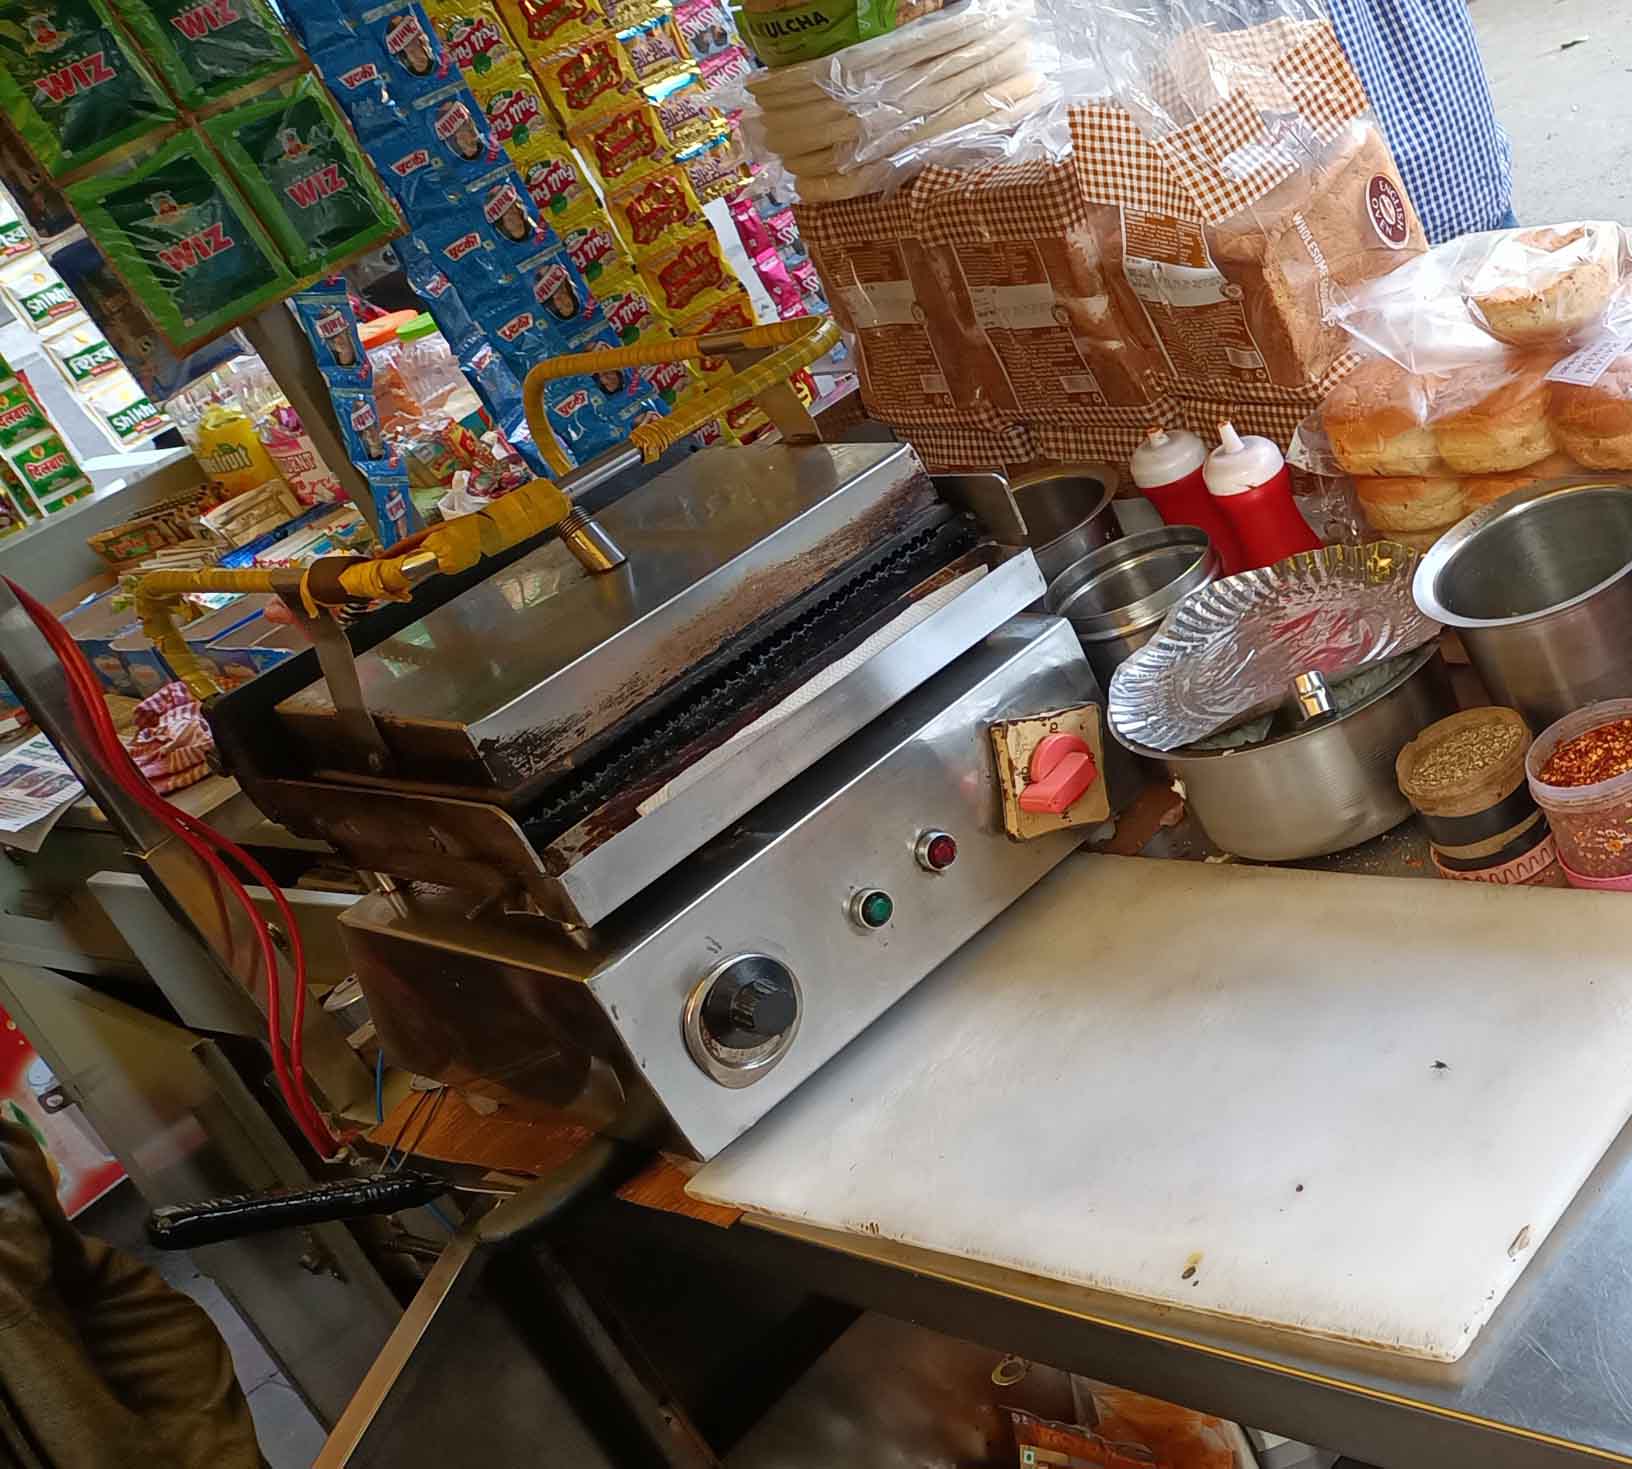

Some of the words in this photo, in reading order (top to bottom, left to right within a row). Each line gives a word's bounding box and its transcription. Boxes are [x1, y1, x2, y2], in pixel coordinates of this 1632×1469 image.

[170, 0, 240, 40] WIZ
[751, 10, 830, 39] ULCHA
[36, 51, 117, 104] WIZ
[287, 163, 348, 209] WIZ
[158, 222, 234, 273] WIZ
